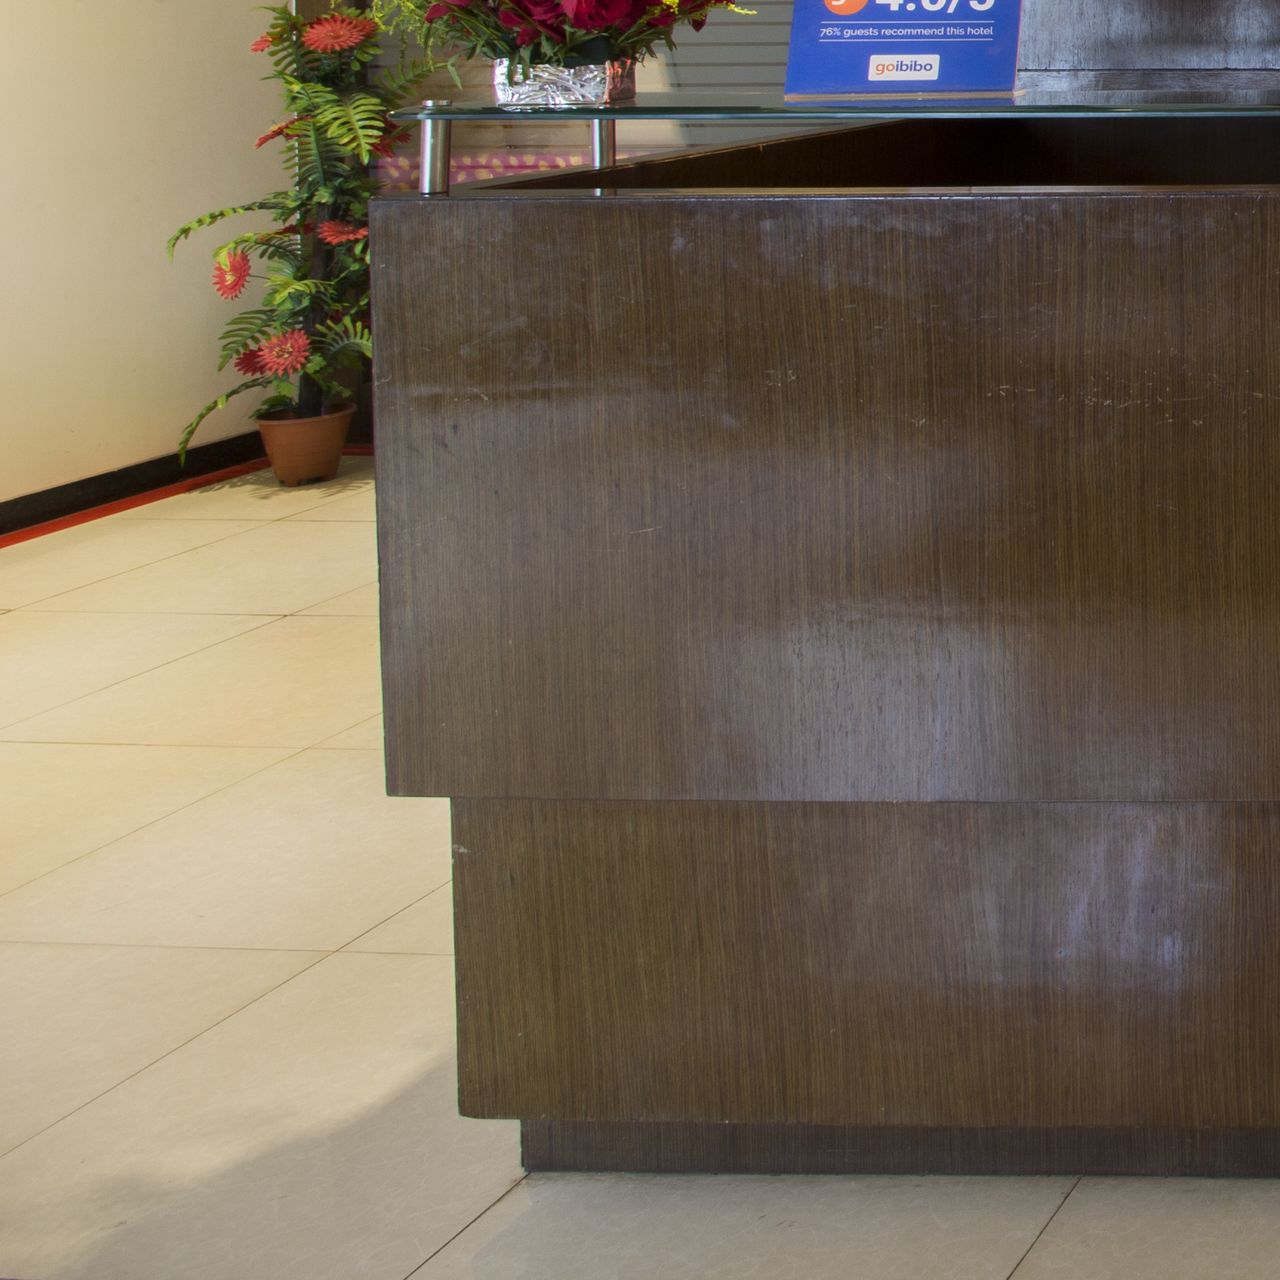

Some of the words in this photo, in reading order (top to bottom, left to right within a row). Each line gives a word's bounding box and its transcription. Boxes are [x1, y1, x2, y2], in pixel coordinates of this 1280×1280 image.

[820, 27, 842, 37] 76%
[843, 27, 879, 38] guests
[881, 27, 945, 36] recommend
[946, 27, 965, 35] this
[967, 26, 993, 35] hotel
[875, 60, 933, 75] goibibo
